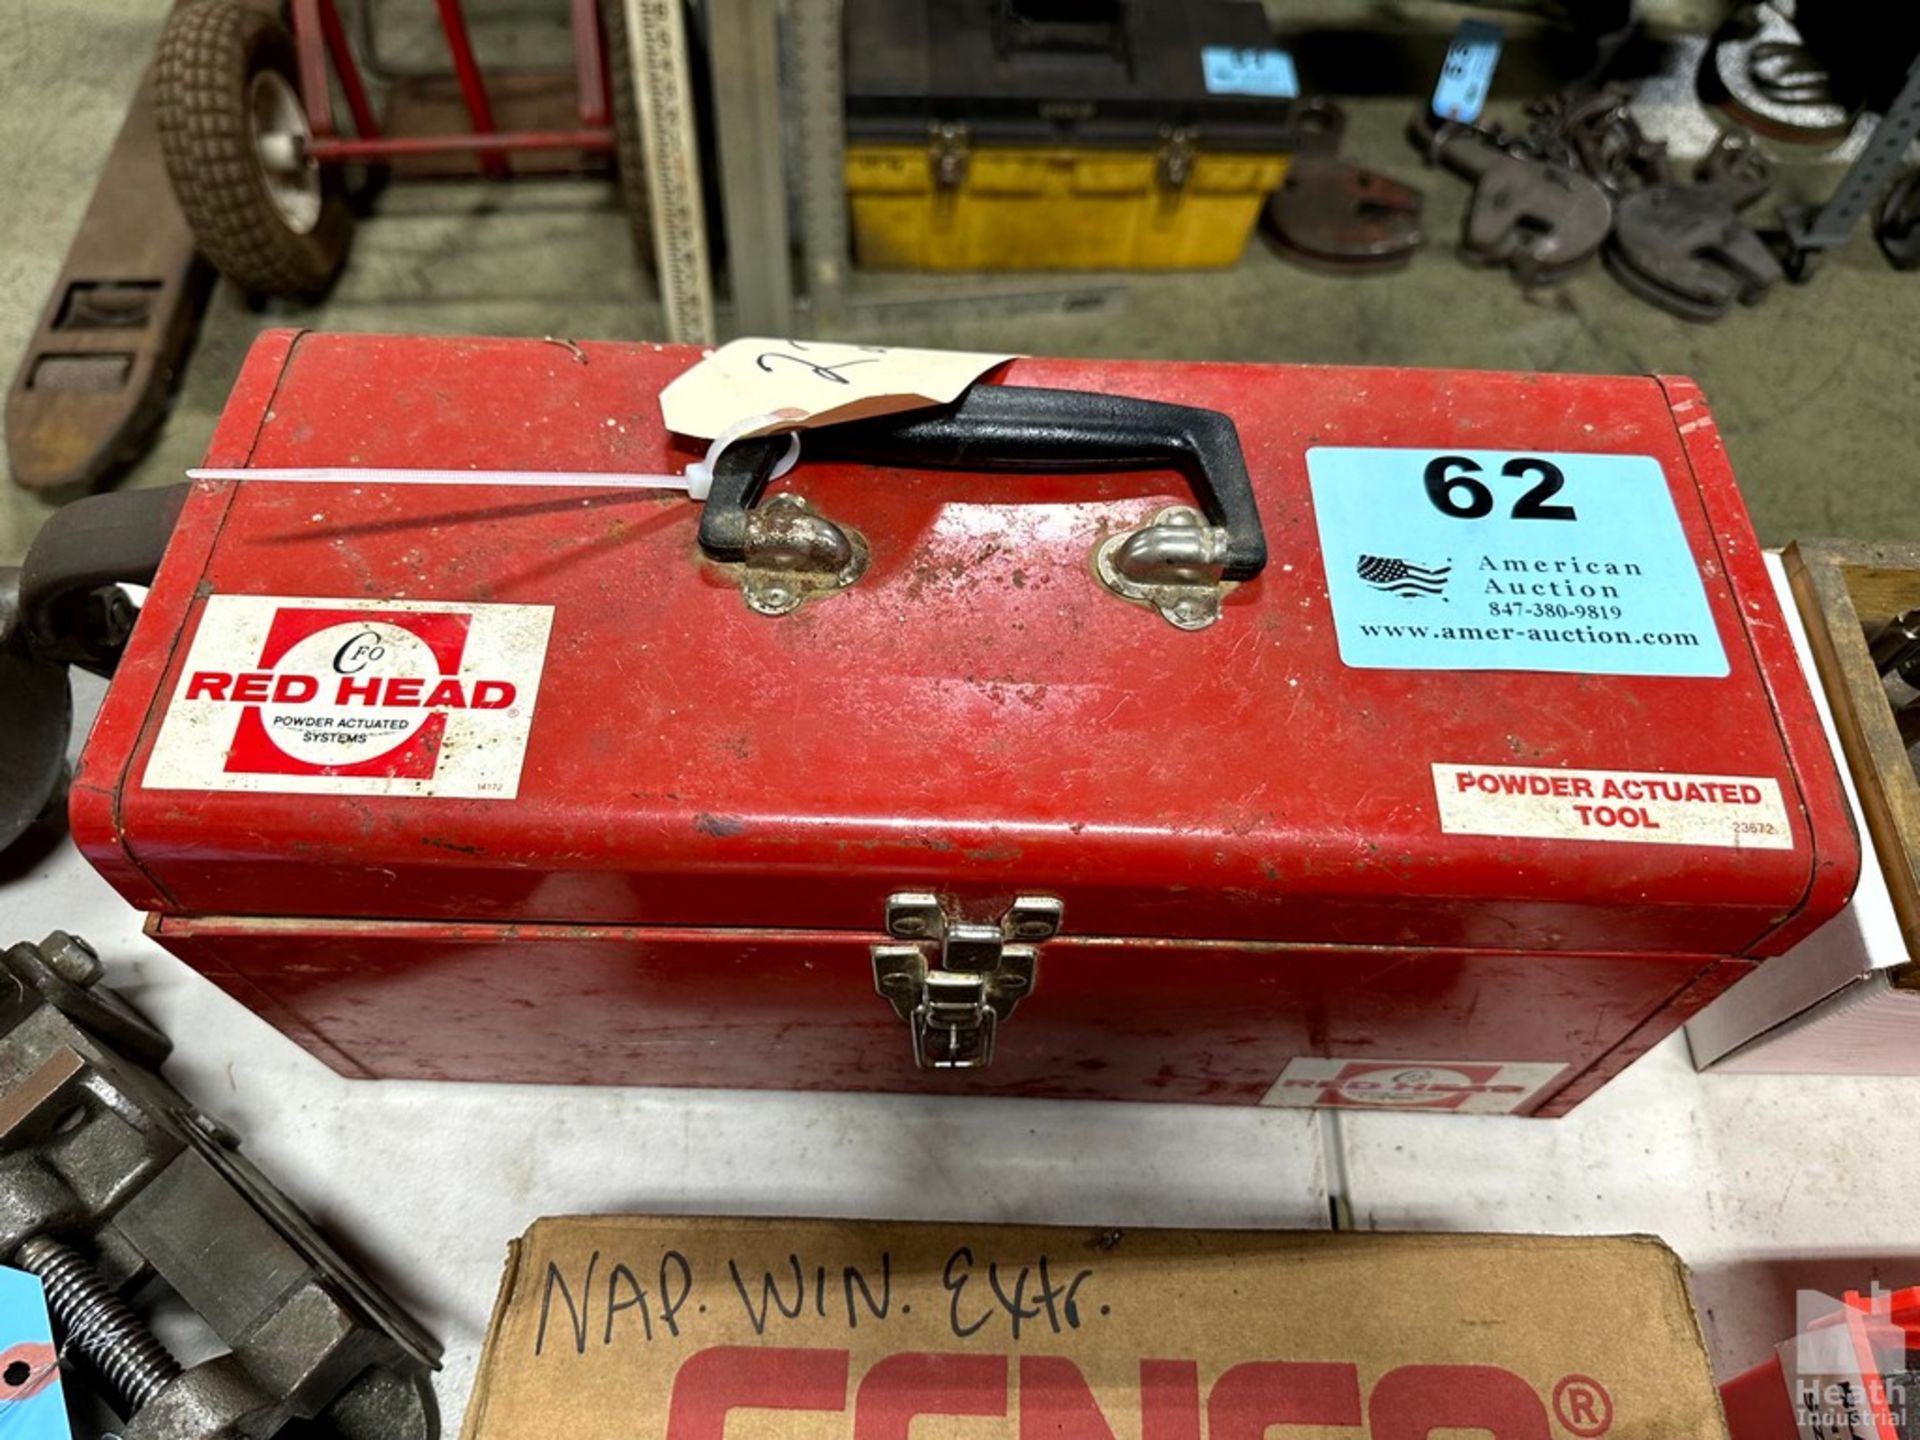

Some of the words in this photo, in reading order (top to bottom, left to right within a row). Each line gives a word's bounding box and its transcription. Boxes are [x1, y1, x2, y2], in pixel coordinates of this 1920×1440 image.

[1423, 456, 1578, 520] 62
[1478, 555, 1642, 577] American
[1484, 579, 1620, 599] Auction
[1488, 601, 1623, 620] 847-380-9819
[1360, 624, 1700, 647] www.amer-auction.com
[185, 671, 319, 702] RED
[335, 676, 517, 709] HEAD
[273, 716, 334, 727] POWDER
[337, 719, 409, 730] ACTUATED
[303, 731, 368, 744] SYSTEMS
[1456, 772, 1594, 798] POWDER
[1602, 779, 1762, 805] ACTUATED
[1574, 805, 1660, 829] TOOL
